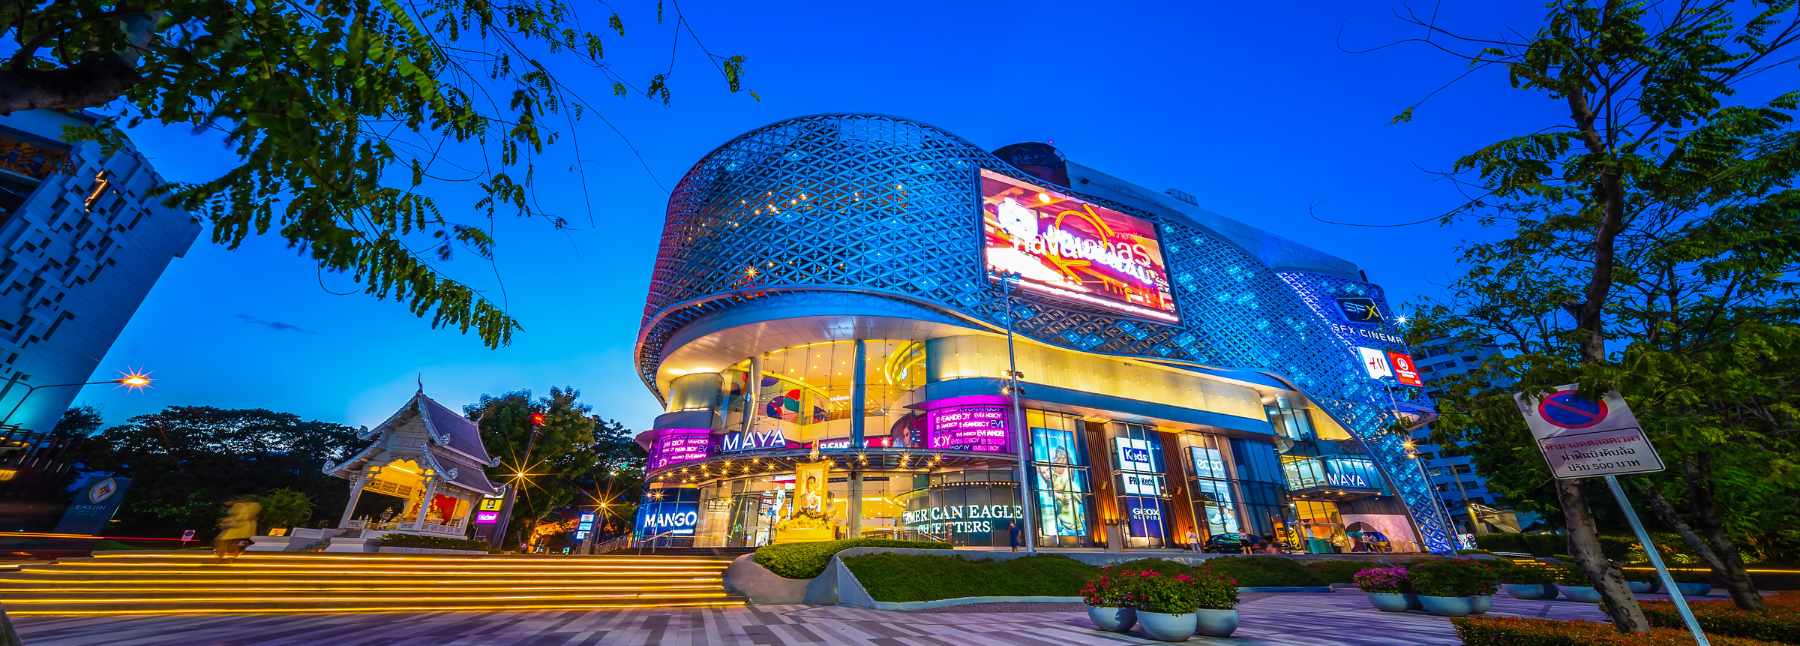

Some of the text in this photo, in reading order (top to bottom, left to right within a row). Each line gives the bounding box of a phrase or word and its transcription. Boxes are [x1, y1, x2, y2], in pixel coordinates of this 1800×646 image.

[723, 429, 786, 451] MAYA
[1327, 473, 1366, 487] MAYA
[644, 511, 697, 528] MANGO
[903, 505, 1023, 525] AMERCAN EAGLE
[918, 520, 991, 535] OUTFTTERS
